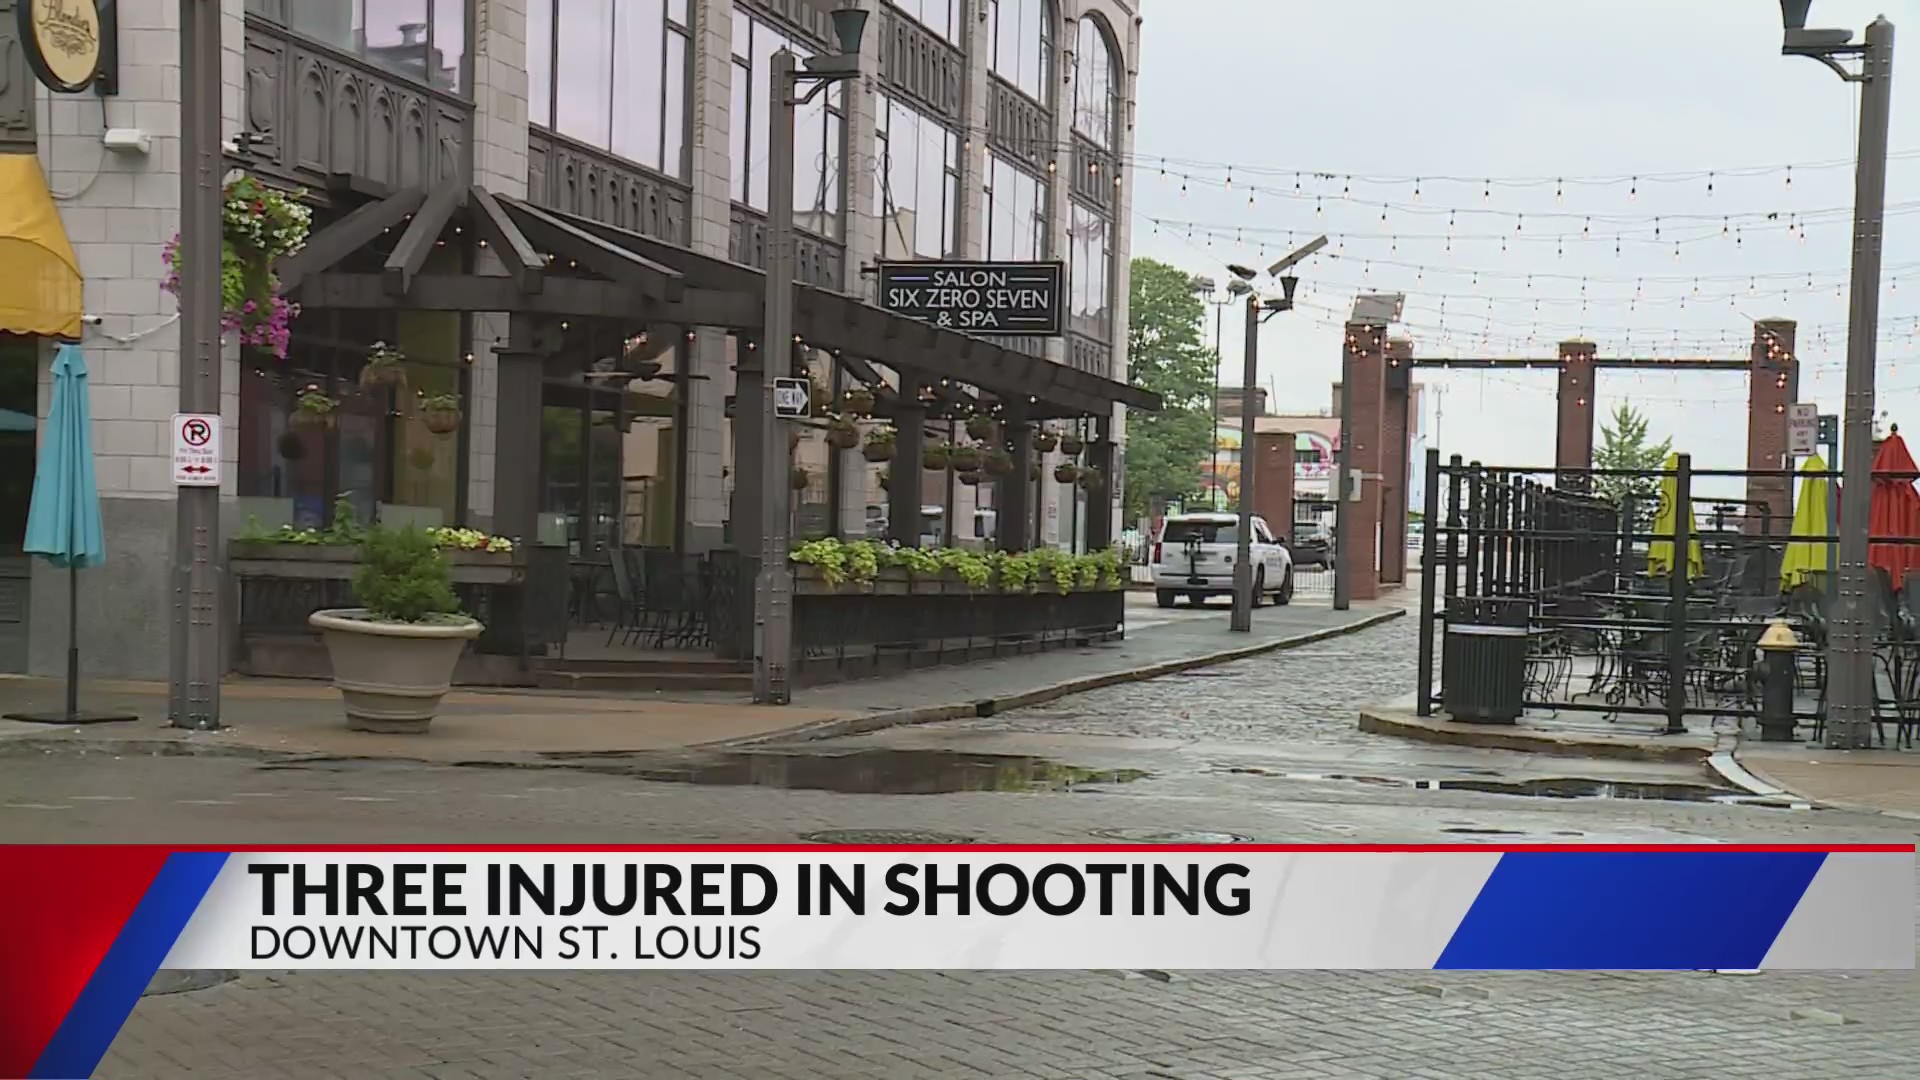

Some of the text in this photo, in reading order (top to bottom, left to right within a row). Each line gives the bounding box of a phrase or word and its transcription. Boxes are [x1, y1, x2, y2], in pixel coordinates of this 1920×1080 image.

[933, 271, 1006, 287] SALON
[888, 288, 1049, 309] SIX ZERO SEVEN
[936, 311, 999, 328] & SPA
